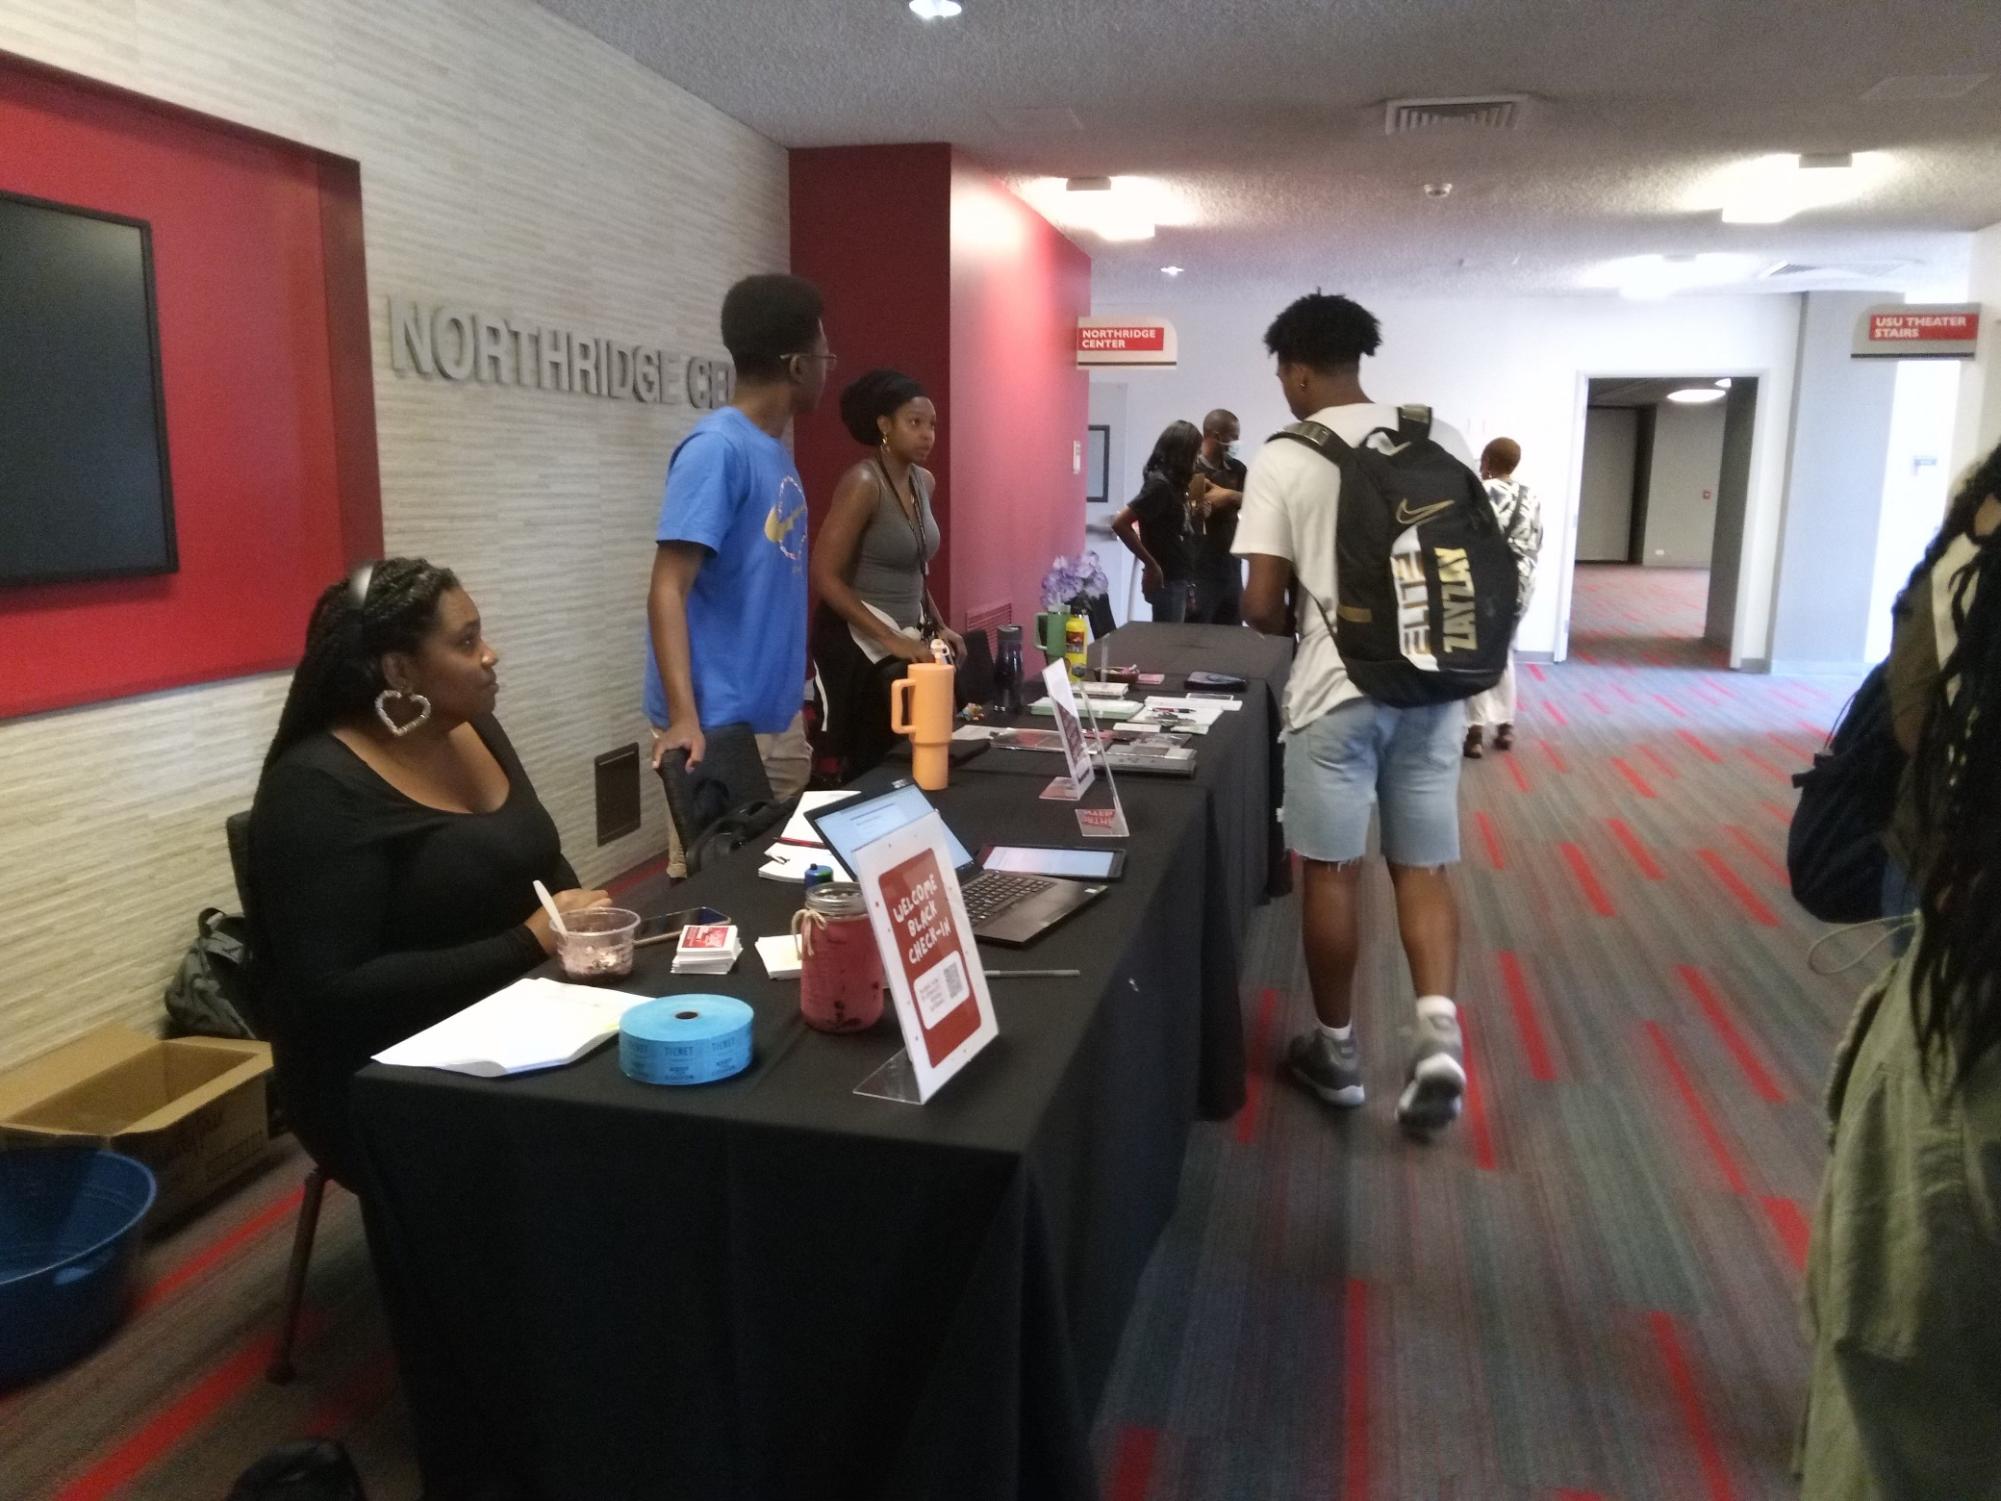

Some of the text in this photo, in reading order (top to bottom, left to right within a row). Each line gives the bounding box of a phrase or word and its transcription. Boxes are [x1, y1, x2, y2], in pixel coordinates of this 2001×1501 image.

[1875, 316, 1967, 327] USU THEATER
[1082, 329, 1156, 339] NORTHRIDGE
[1874, 328, 1920, 338] STAIRS
[1082, 339, 1126, 349] CENTER
[387, 297, 682, 405] NORTHRIDGE
[893, 873, 938, 923] WELCOME
[907, 900, 938, 938] BLACK
[908, 916, 952, 965] CHECK-IN
[663, 1046, 694, 1056] TICKET
